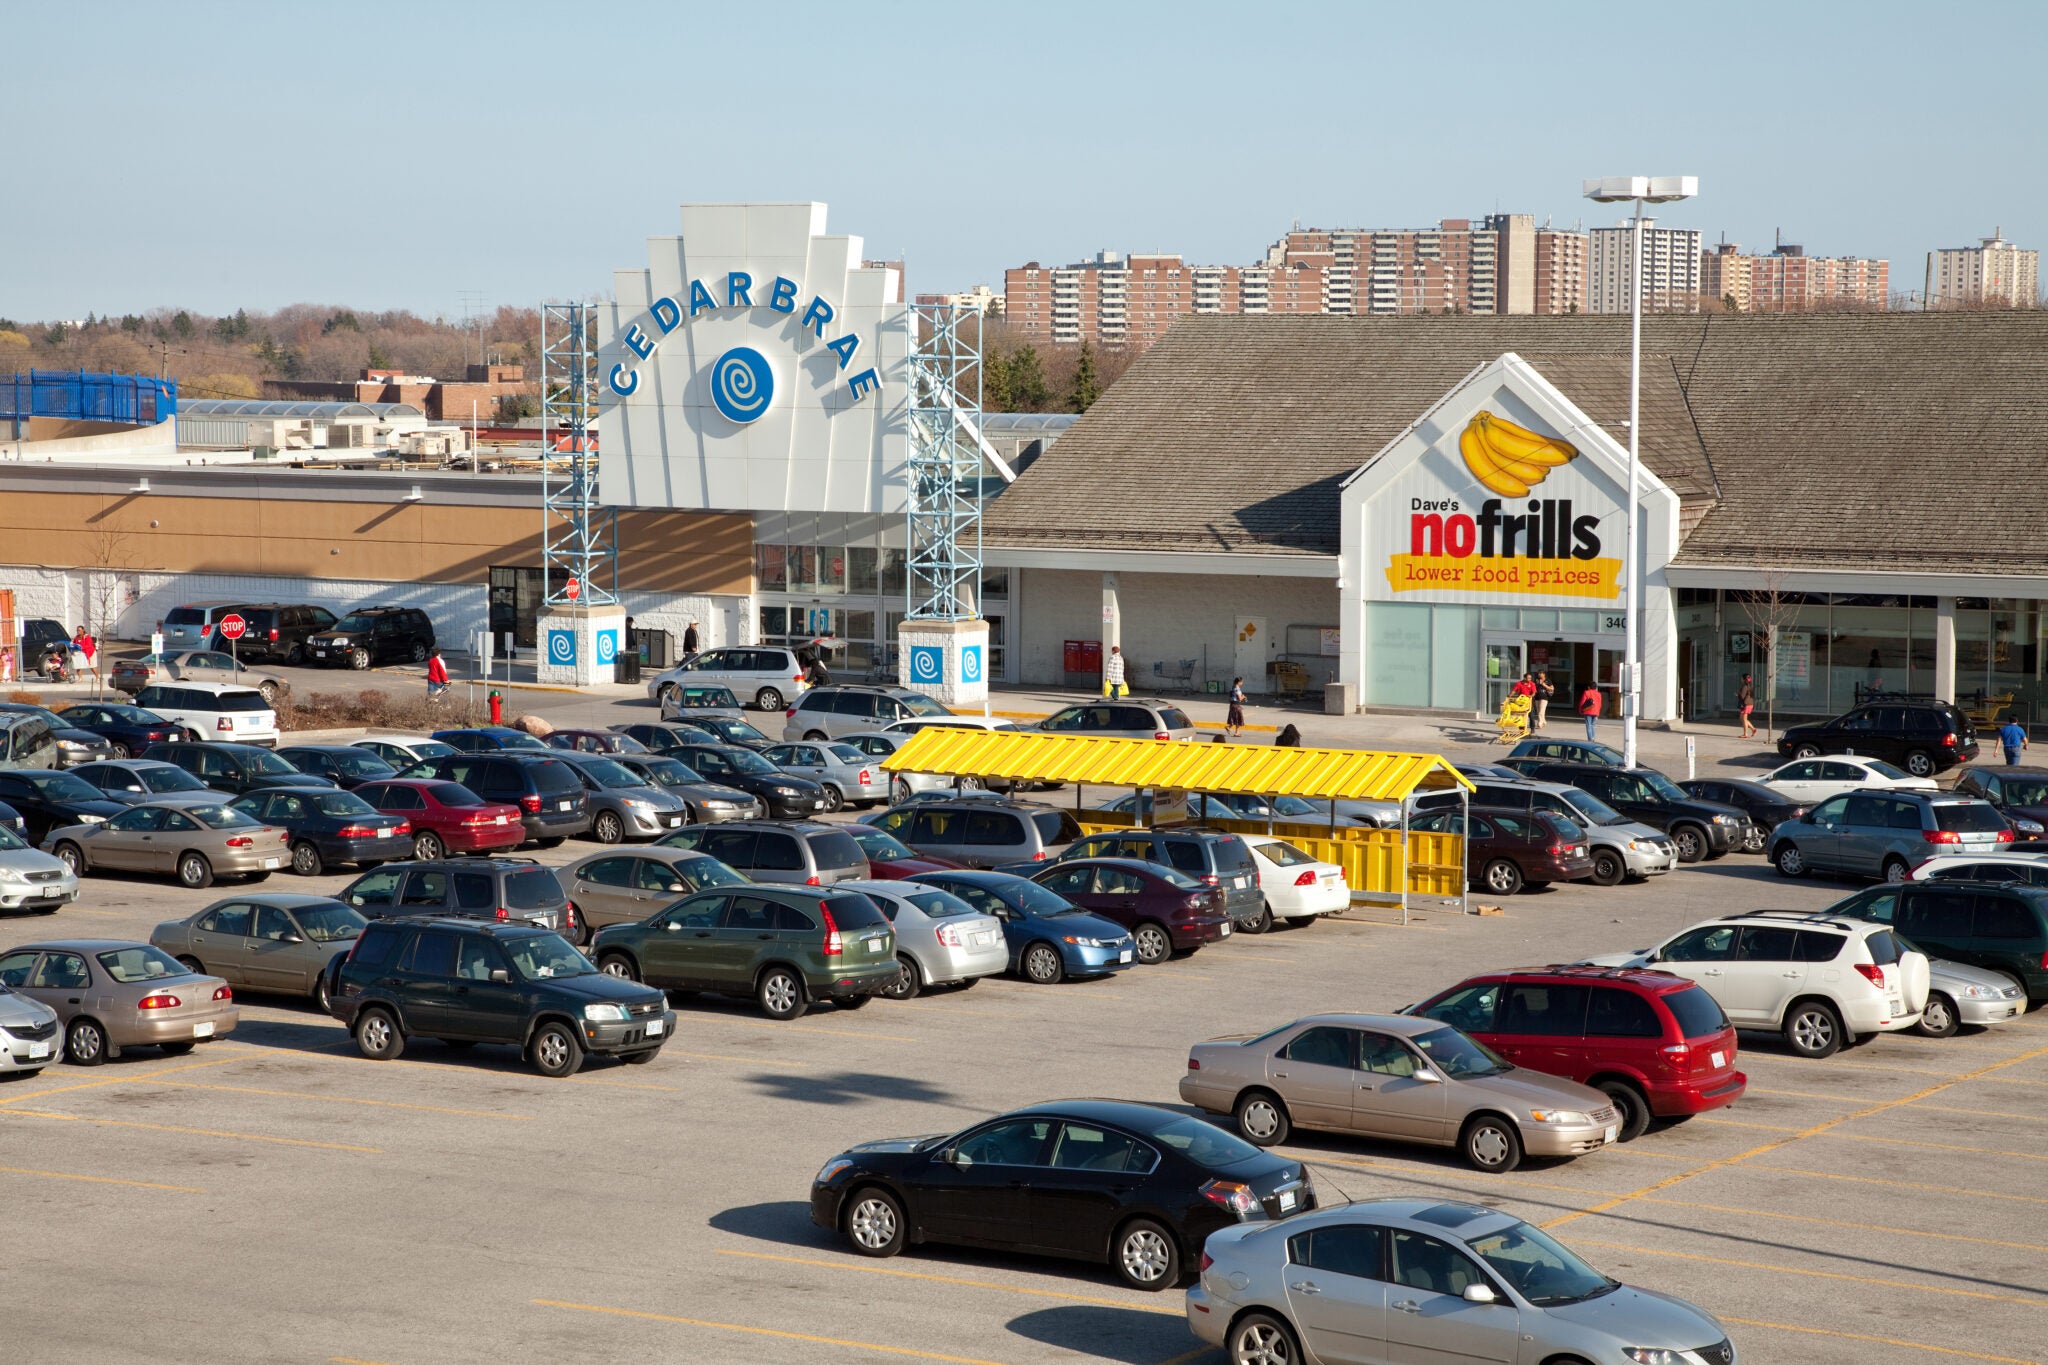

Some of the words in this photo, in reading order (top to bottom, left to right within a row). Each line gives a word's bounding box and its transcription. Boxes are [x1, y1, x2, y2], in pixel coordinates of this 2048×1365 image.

[608, 271, 884, 401] CEDARBRAE
[1411, 498, 1459, 511] Dave's
[1405, 564, 1463, 581] lower
[1472, 565, 1520, 583] food
[1527, 567, 1600, 587] prices
[567, 585, 579, 594] STOP
[222, 621, 244, 632] STOP
